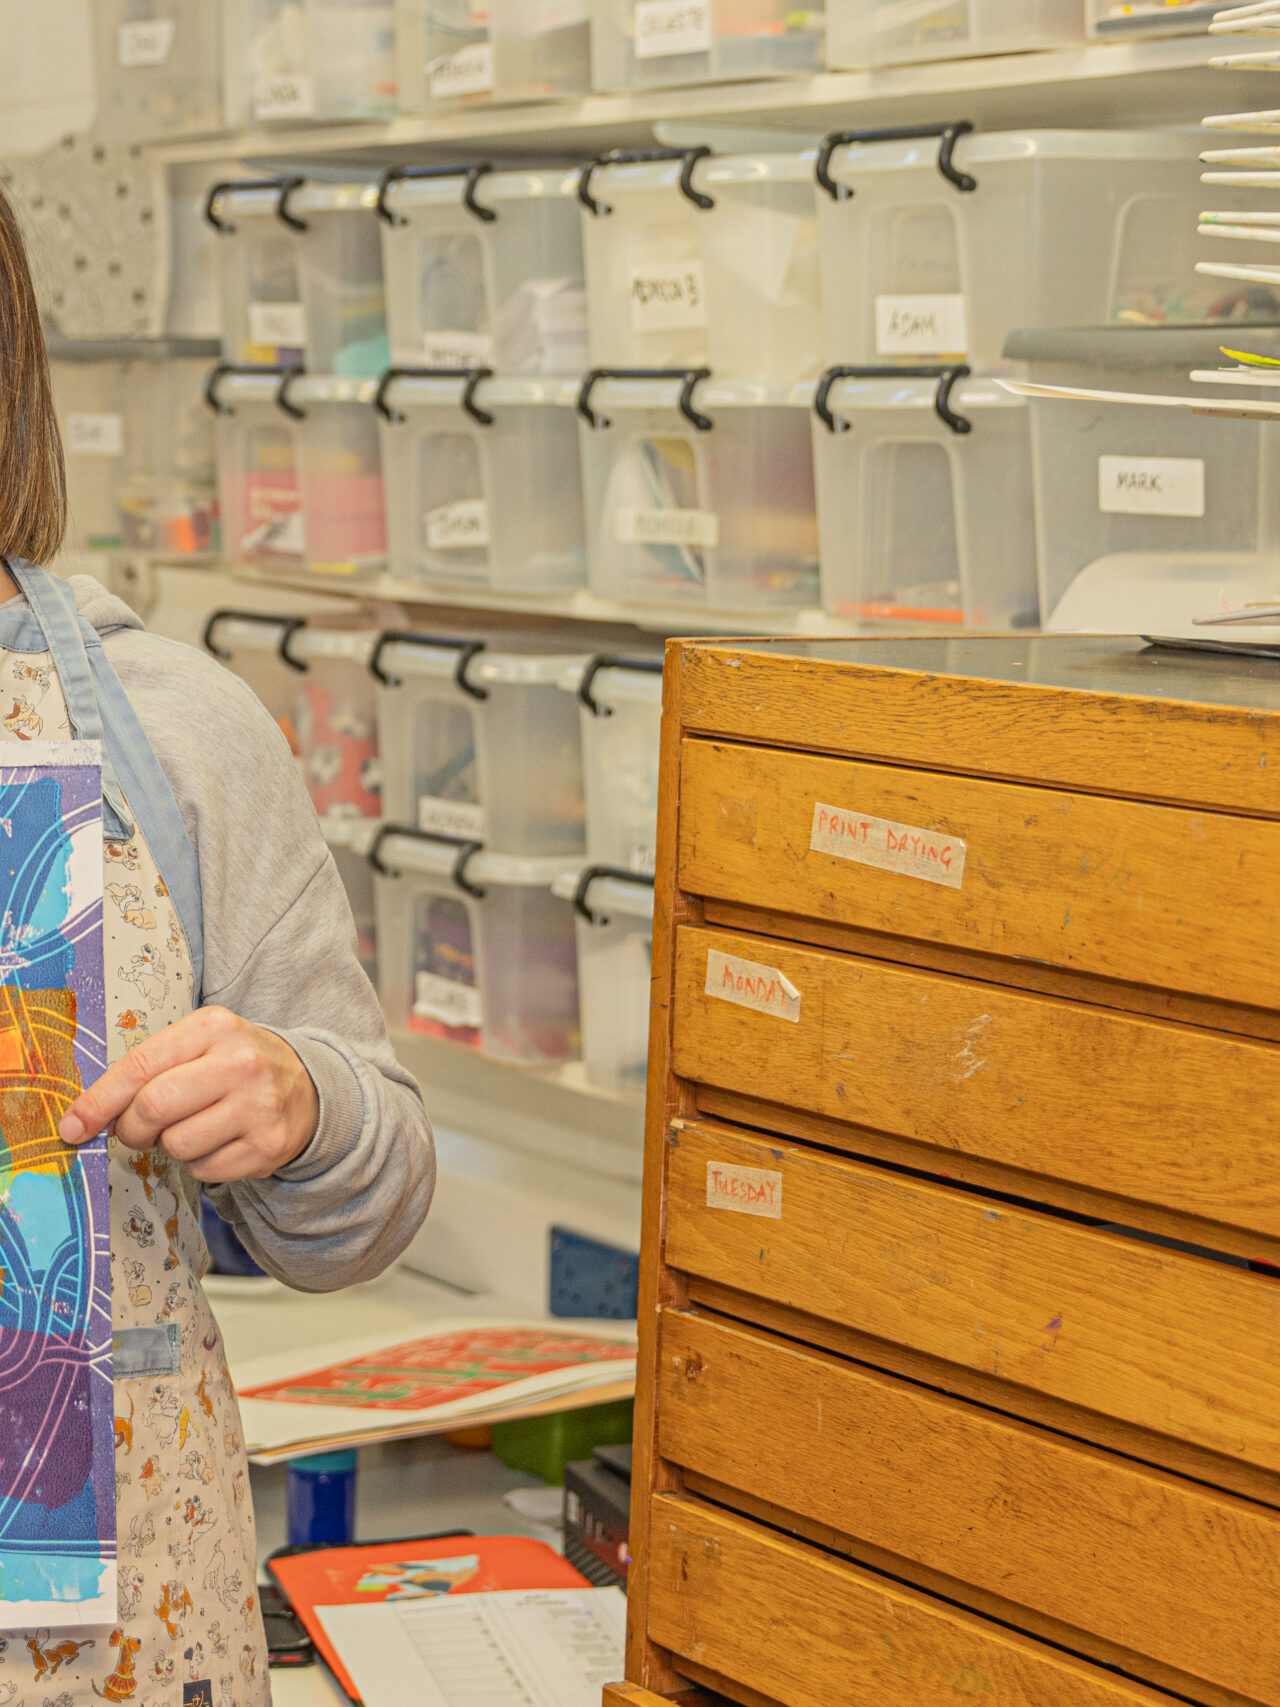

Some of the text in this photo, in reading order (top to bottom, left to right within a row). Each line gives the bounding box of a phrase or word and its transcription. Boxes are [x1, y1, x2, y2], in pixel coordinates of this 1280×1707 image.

[886, 307, 938, 339] ADAM
[1115, 469, 1165, 494] MARK
[818, 809, 953, 872] PRINT DRYING
[721, 963, 787, 1007] MONDAY
[711, 1170, 778, 1206] TUESDAY
